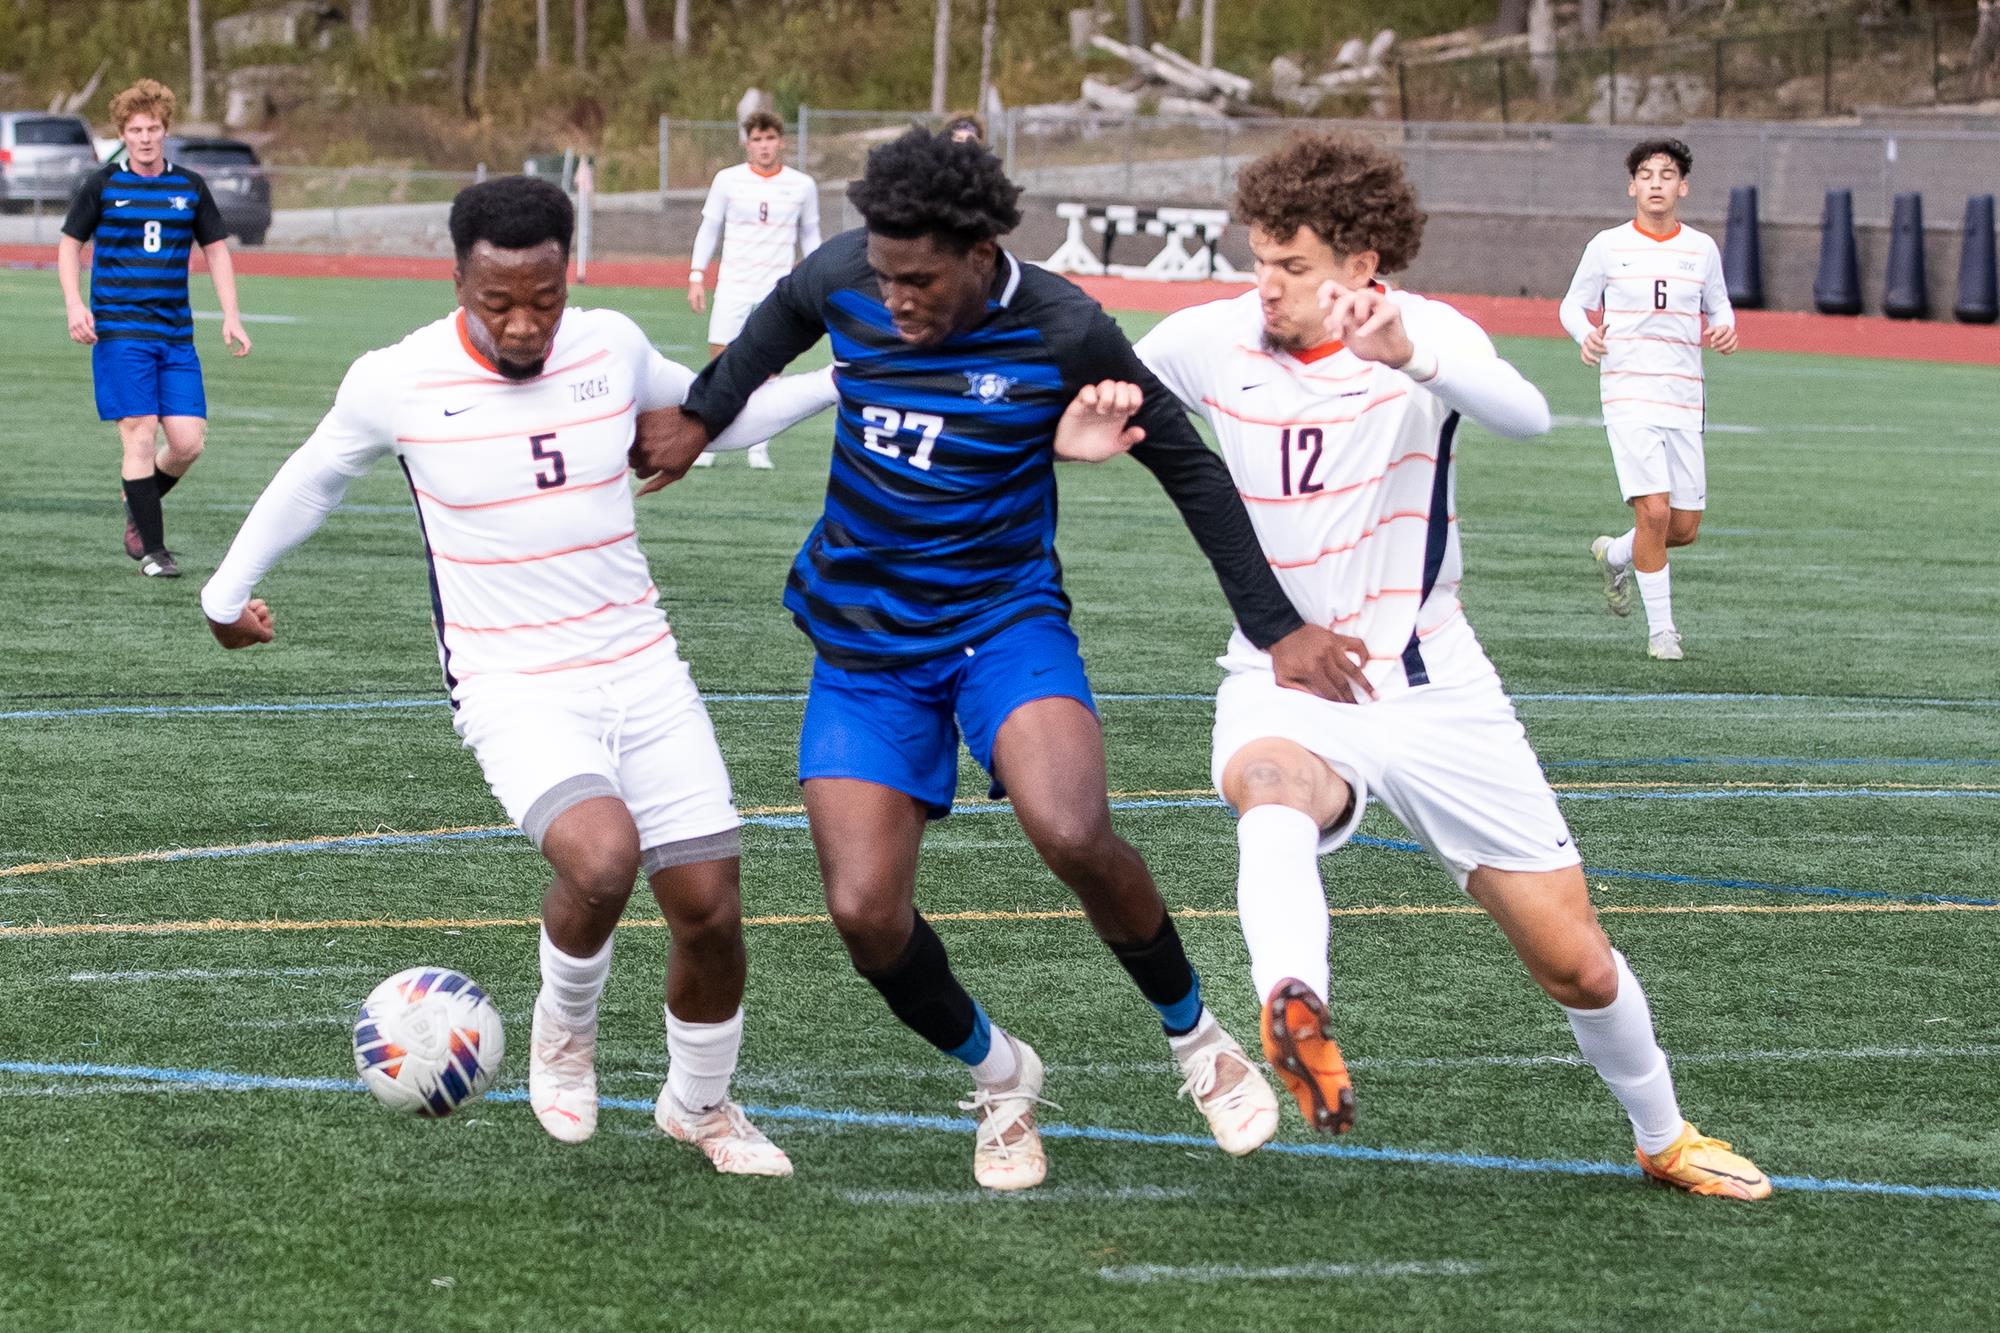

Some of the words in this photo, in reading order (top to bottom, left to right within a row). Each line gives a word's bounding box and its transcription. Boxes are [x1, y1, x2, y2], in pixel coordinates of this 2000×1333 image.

[759, 201, 768, 222] 9
[143, 220, 162, 253] 8
[1654, 279, 1667, 310] 6
[862, 405, 944, 471] 27
[529, 432, 567, 490] 5
[1280, 427, 1324, 496] 12
